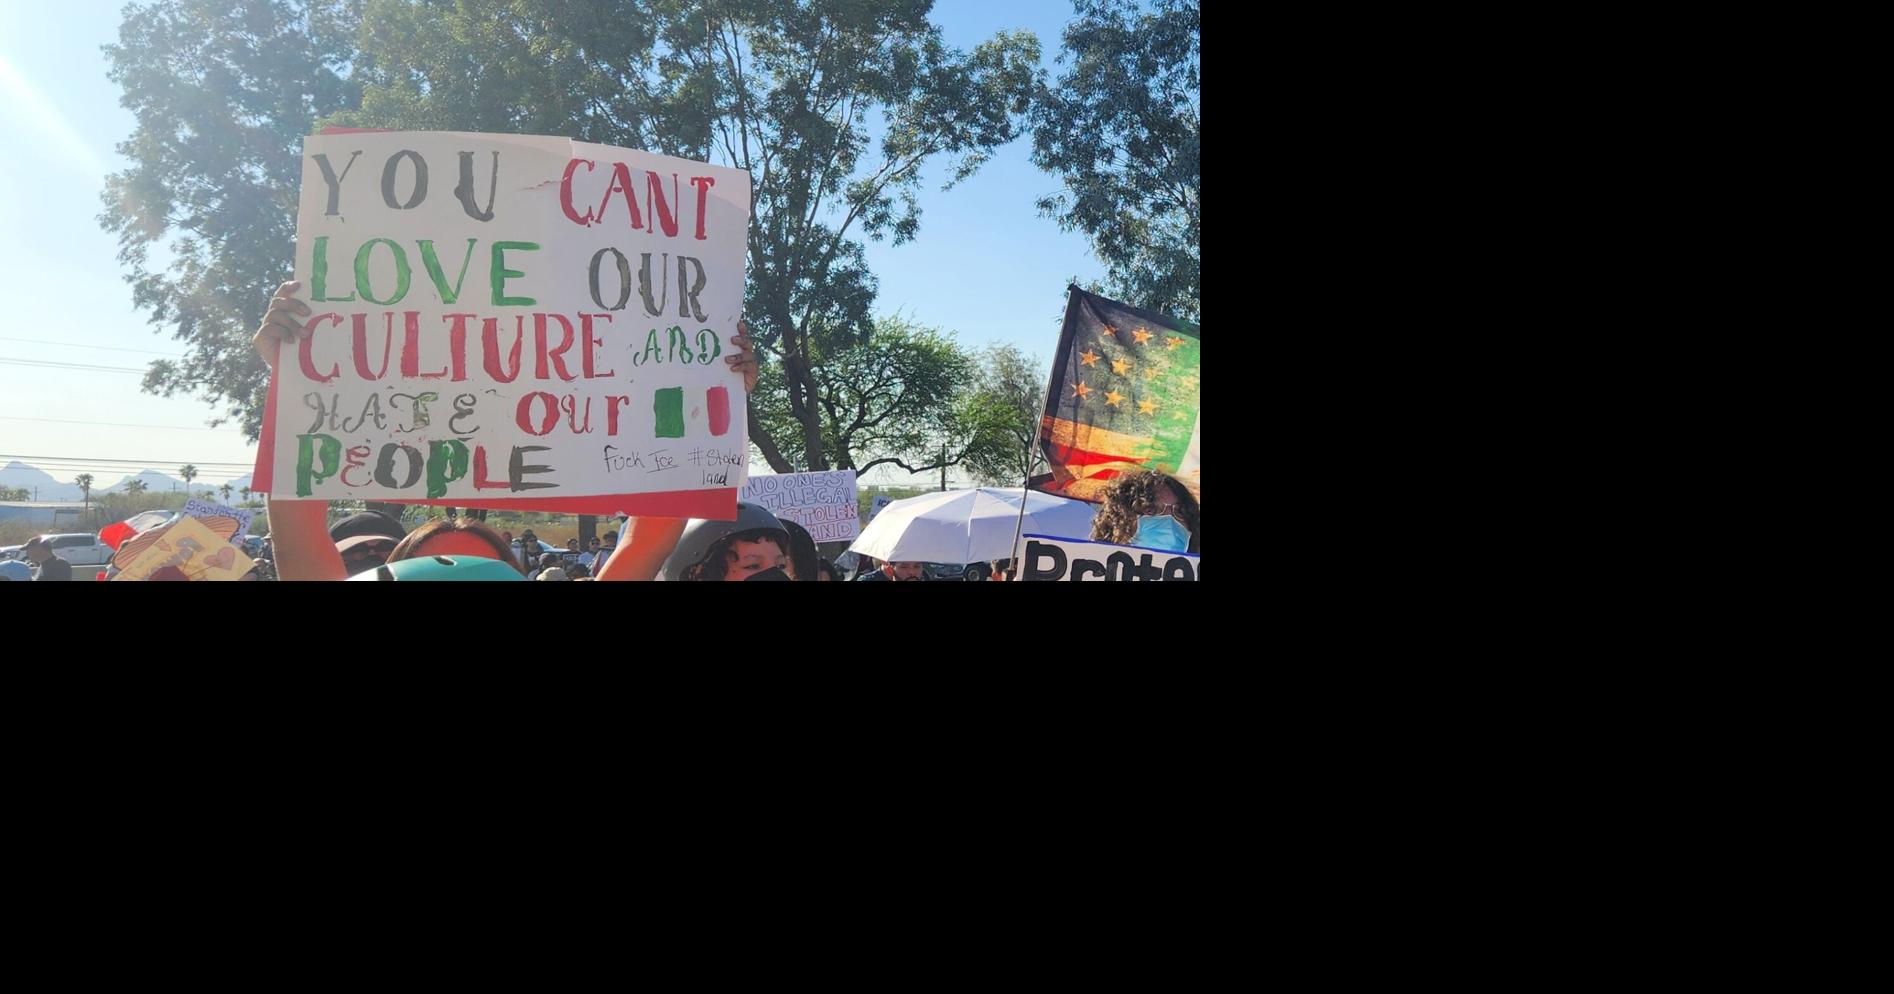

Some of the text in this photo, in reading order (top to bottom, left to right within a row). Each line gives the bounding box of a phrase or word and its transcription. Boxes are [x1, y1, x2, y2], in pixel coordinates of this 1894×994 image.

[311, 149, 715, 240] YOU CANT
[310, 236, 708, 322] LOVE OUR
[298, 311, 721, 383] CULTURE AND
[303, 391, 480, 435] HATE
[296, 433, 560, 498] PEOPLE
[742, 476, 778, 499] NO
[783, 504, 858, 525] STOLEN
[806, 521, 852, 540] AND
[1023, 540, 1200, 581] Prote
